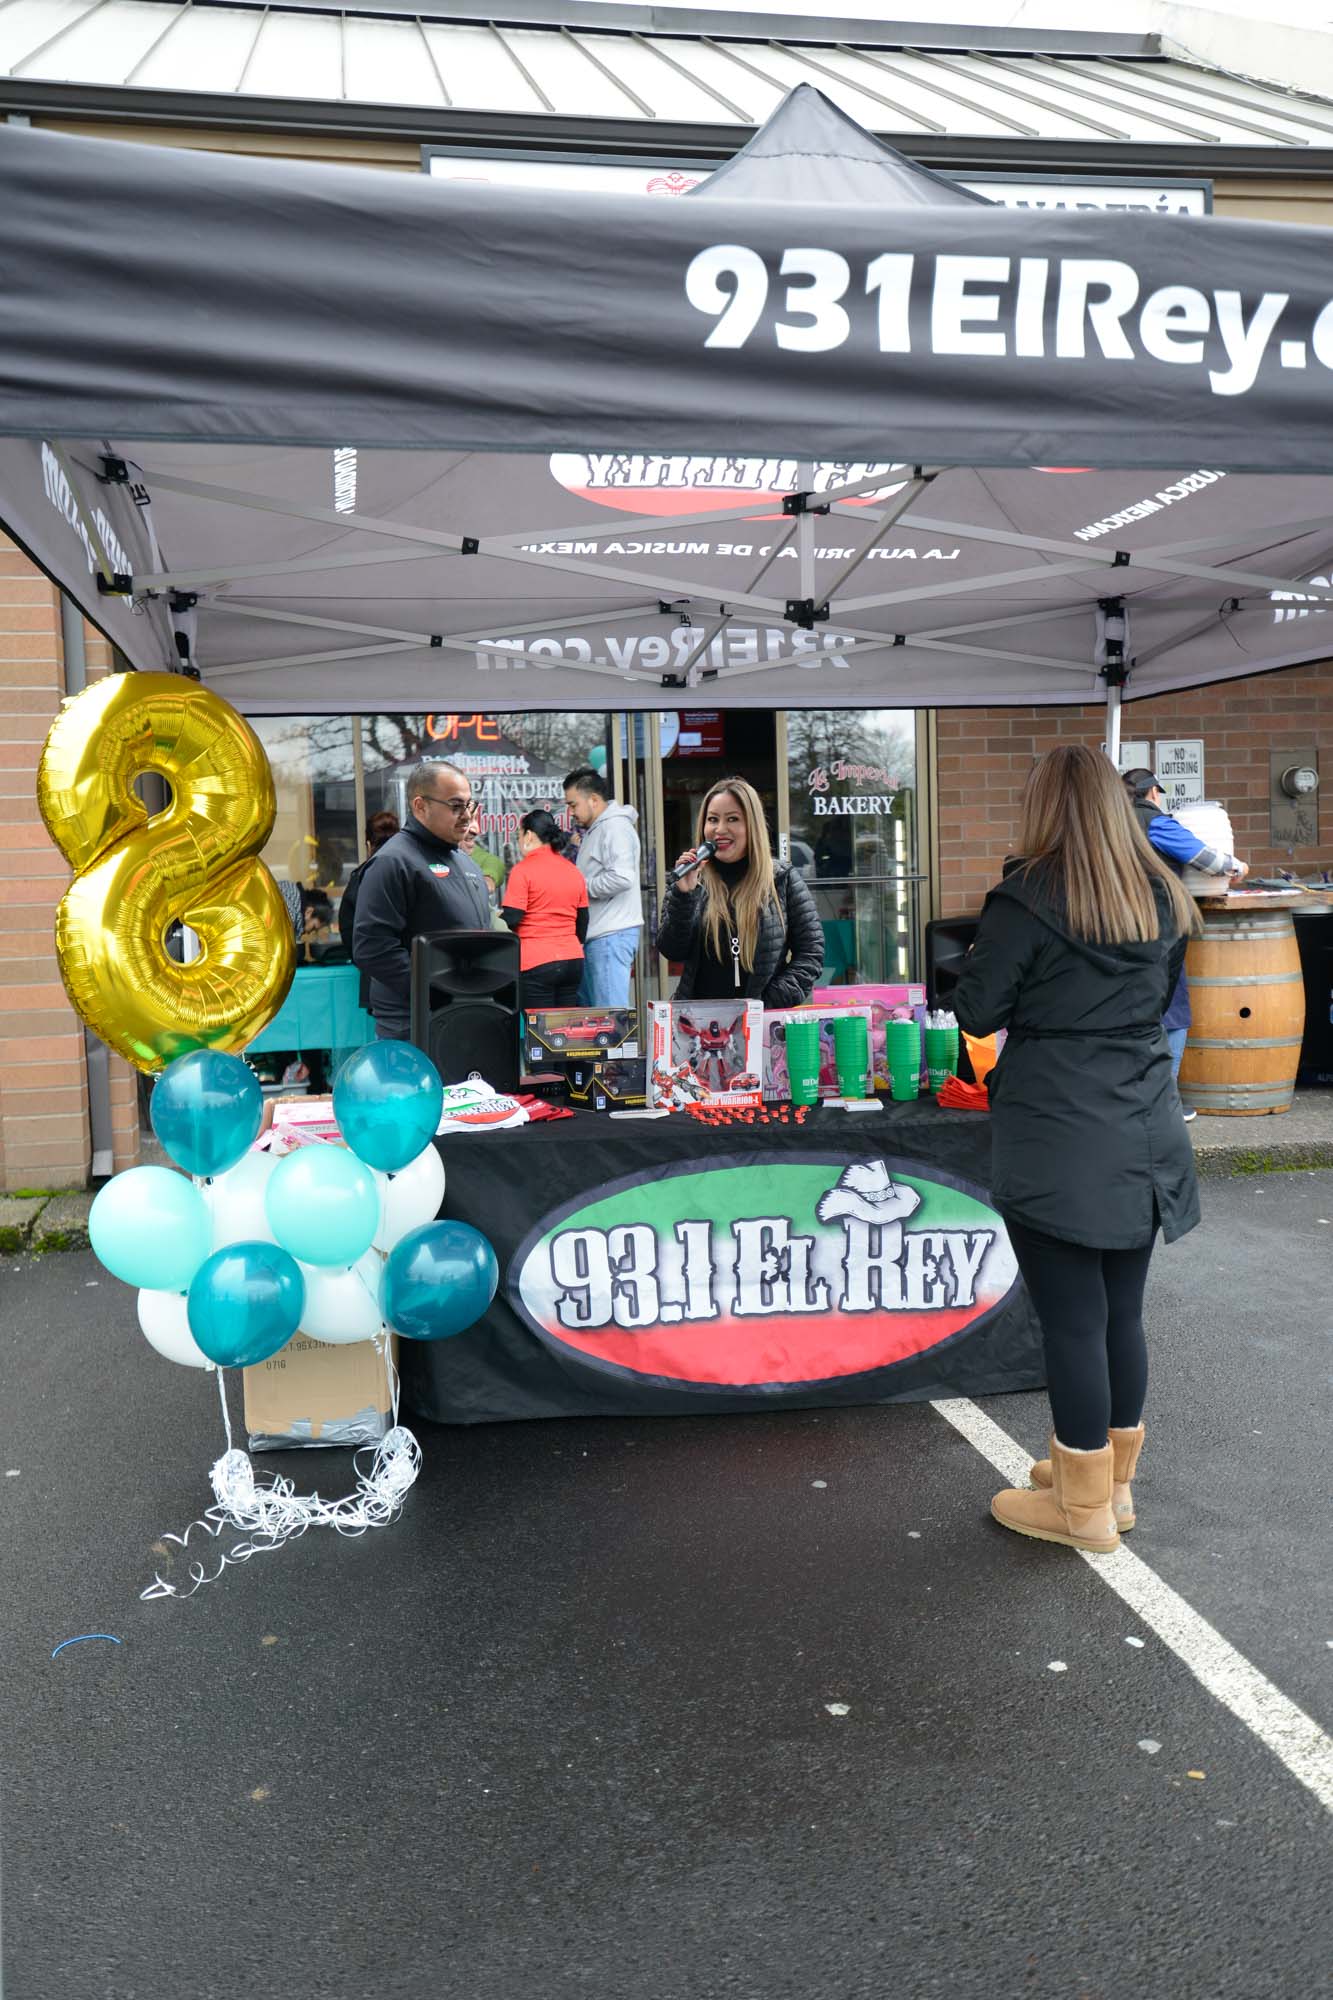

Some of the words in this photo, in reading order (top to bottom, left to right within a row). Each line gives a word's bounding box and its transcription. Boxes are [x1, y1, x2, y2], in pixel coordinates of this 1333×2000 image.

[1174, 747, 1185, 760] NO
[1161, 761, 1198, 775] LOITERING
[1175, 783, 1186, 796] NO
[813, 796, 895, 815] BAKERY
[550, 1217, 720, 1330] 93.1
